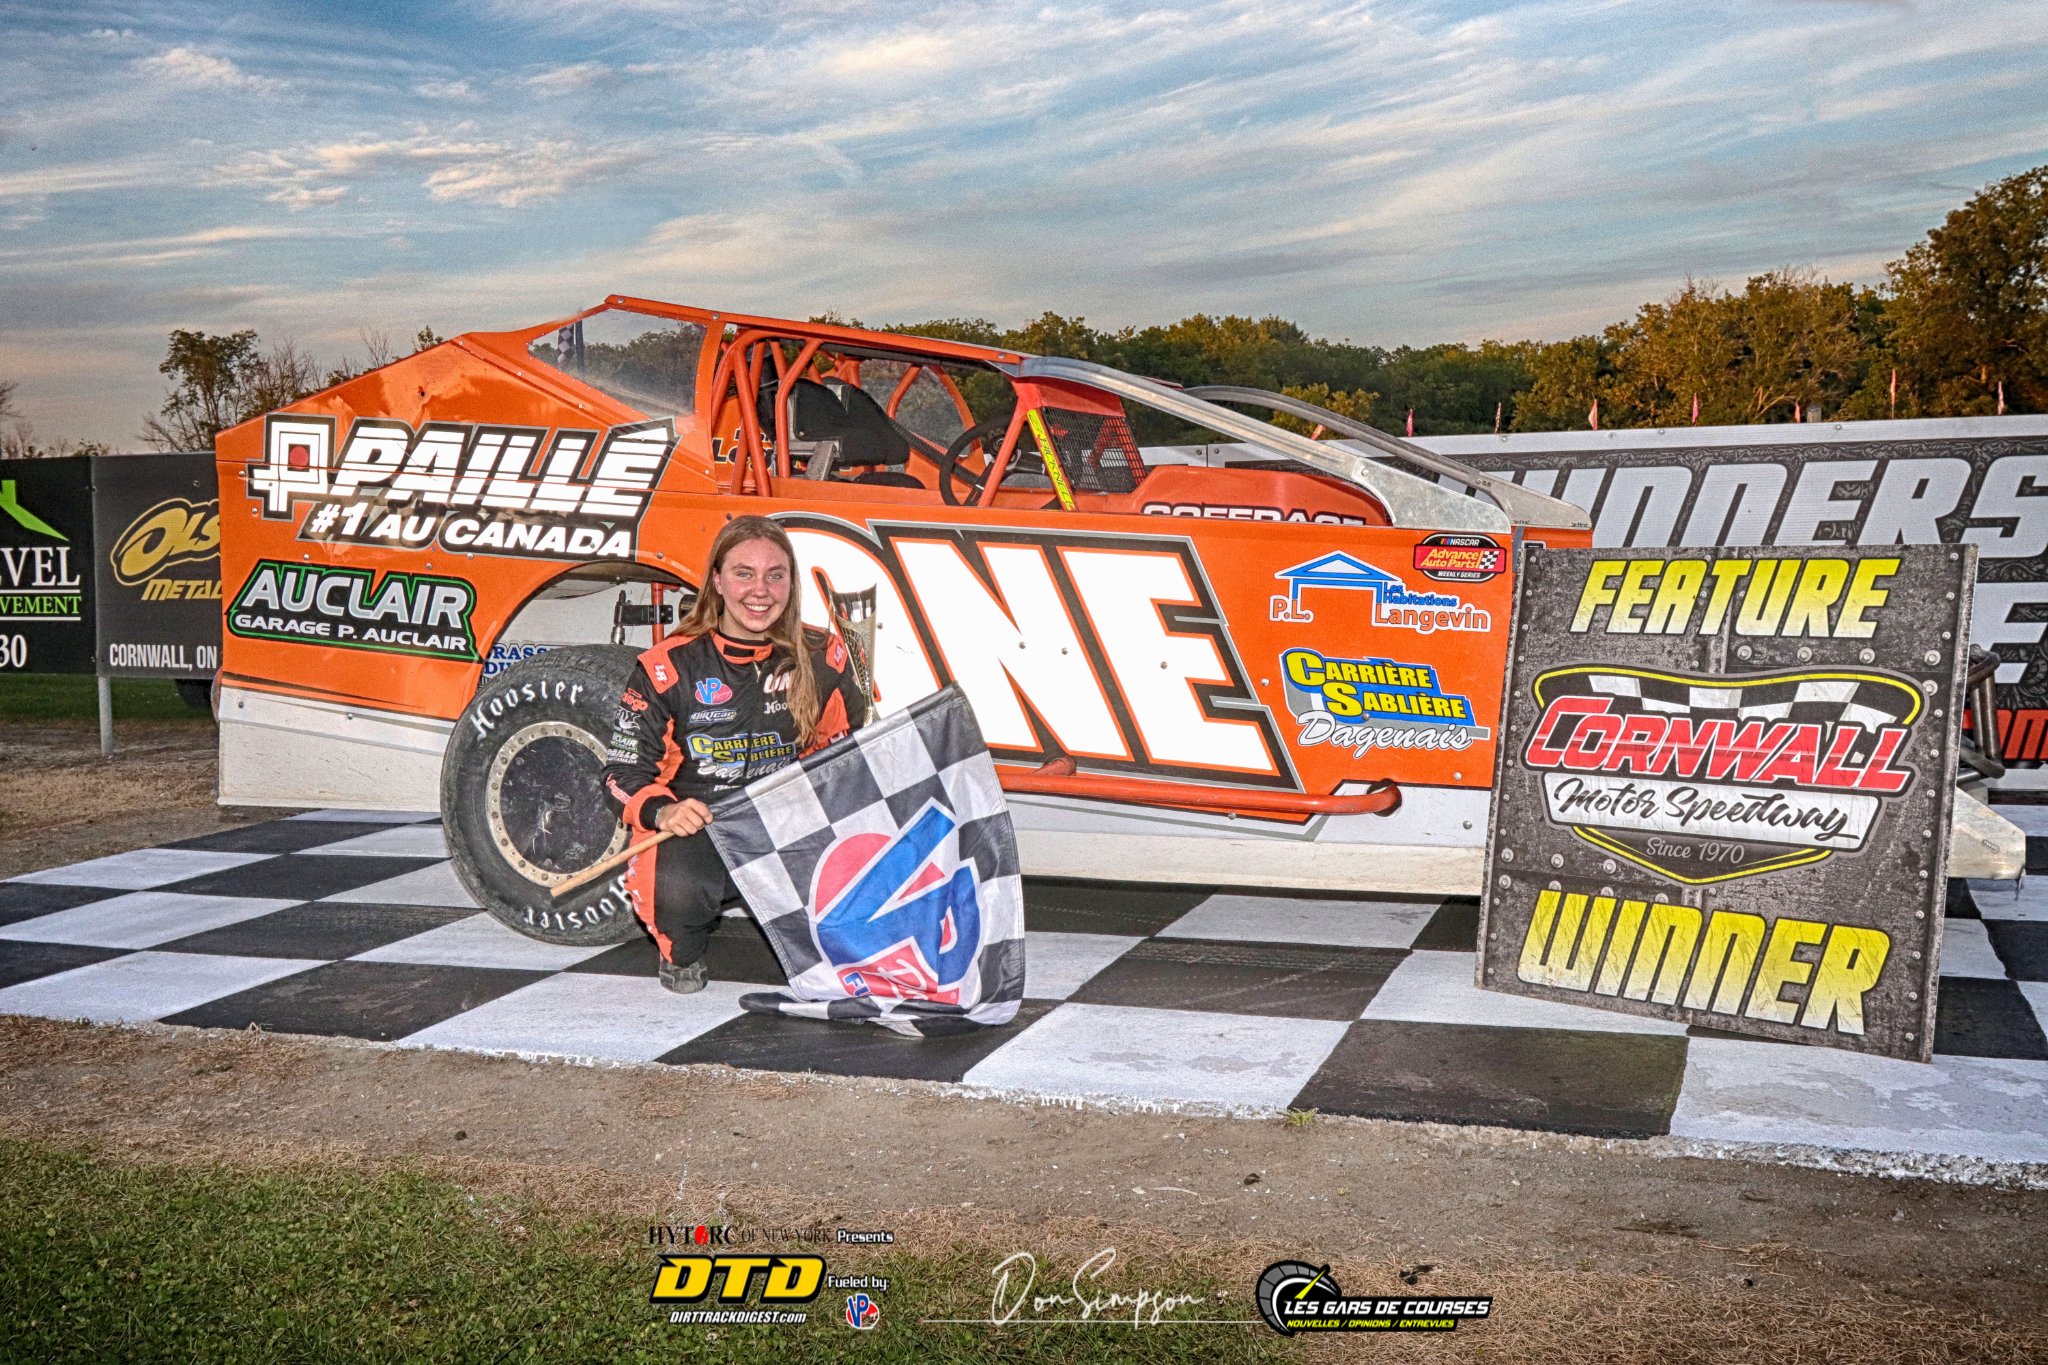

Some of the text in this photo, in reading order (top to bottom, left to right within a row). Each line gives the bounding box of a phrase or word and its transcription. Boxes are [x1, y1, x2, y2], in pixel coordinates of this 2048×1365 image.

[330, 427, 669, 517] PAILLÉ
[1434, 455, 2048, 560] NNERS
[311, 503, 631, 557] #1 AU CANADA
[1450, 538, 1480, 546] NASCAR
[0, 547, 80, 587] VEL
[1420, 558, 1477, 569] Auto Parts
[1427, 549, 1479, 560] Advance
[246, 569, 467, 629] AUCLAIR
[1383, 592, 1457, 607] Habitations
[1384, 582, 1403, 593] Les
[1570, 558, 1901, 638] FEATURE
[1272, 599, 1310, 619] P.L.
[1375, 604, 1488, 631] Langevin
[235, 614, 466, 651] GARAGE P. AUCLAIR
[109, 643, 217, 671] CORNWALL, ON
[1287, 652, 1433, 687] CARRIÈRE
[470, 680, 583, 741] Hoosier
[1322, 681, 1467, 719] SABLIÈRE
[1297, 711, 1473, 757] Dagenais
[1526, 696, 1911, 792] CORNWALL
[1554, 777, 1861, 846] Motor Speedway
[1646, 837, 1745, 864] Since 1970
[1517, 889, 1891, 1036] WINNER
